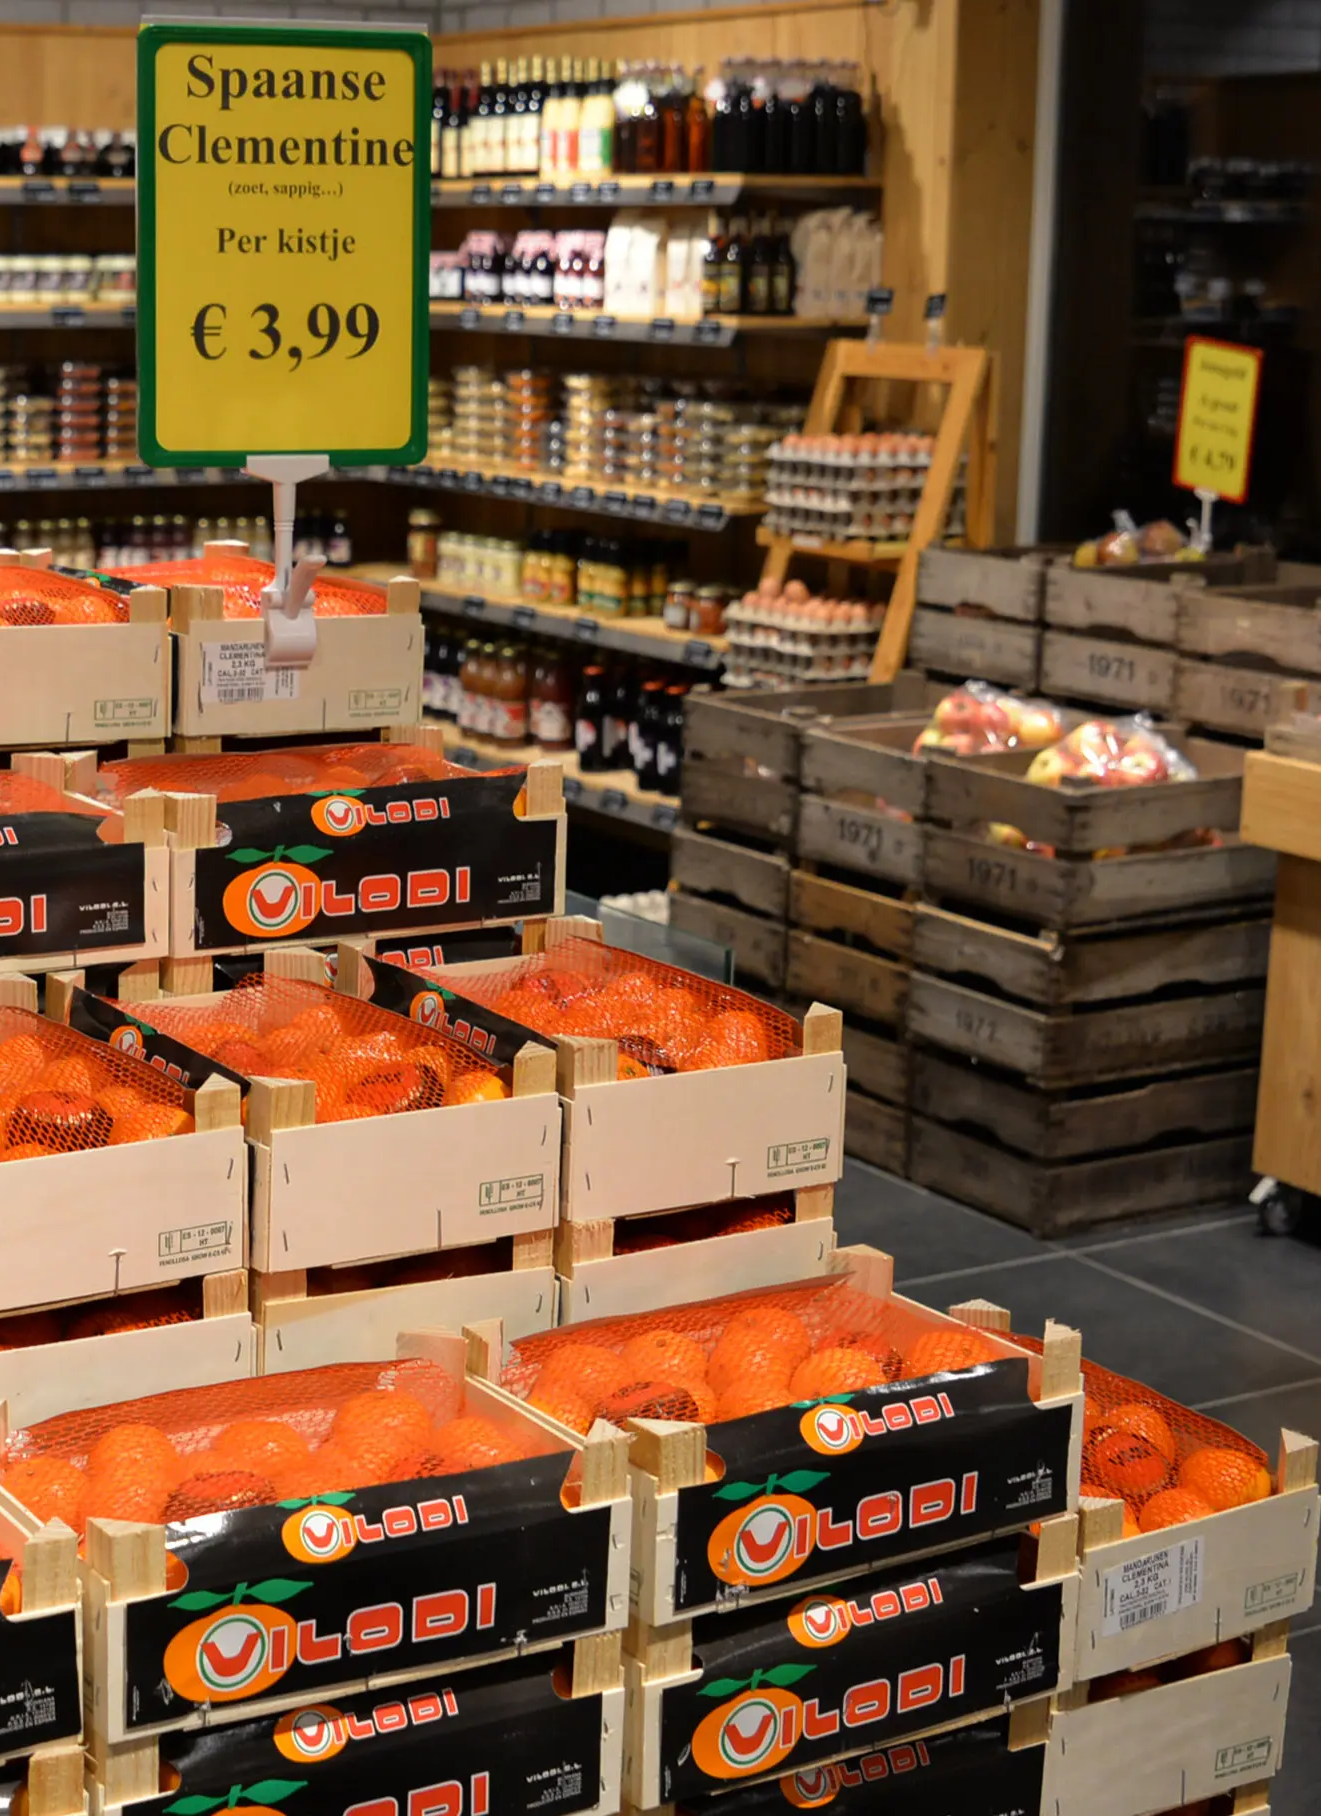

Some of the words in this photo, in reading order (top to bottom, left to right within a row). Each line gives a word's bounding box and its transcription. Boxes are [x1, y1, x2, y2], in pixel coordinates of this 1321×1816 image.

[187, 54, 386, 110] Spaanse
[158, 124, 415, 167] Clementine
[228, 181, 269, 196] (zoet,
[216, 228, 267, 254] Per
[278, 228, 356, 261] kistje
[190, 303, 227, 360] €
[249, 303, 380, 372] 3,99
[244, 660, 255, 668] KG
[1088, 653, 1135, 683] 1971
[327, 796, 450, 827] VILODI
[838, 818, 883, 849] 1971
[252, 866, 470, 920] VILODI
[967, 856, 1017, 891] 1971
[817, 1392, 954, 1441] VILODI
[303, 1495, 469, 1550] VILODI
[739, 1470, 978, 1563] VILODI
[1121, 1560, 1169, 1583] CLEMENTINA
[1147, 1573, 1159, 1584] KG
[201, 1582, 496, 1677] VILODI
[805, 1577, 944, 1636] VILODI
[294, 1688, 459, 1746] VILODI
[725, 1654, 965, 1755] VILODI
[795, 1741, 931, 1796] VILODI
